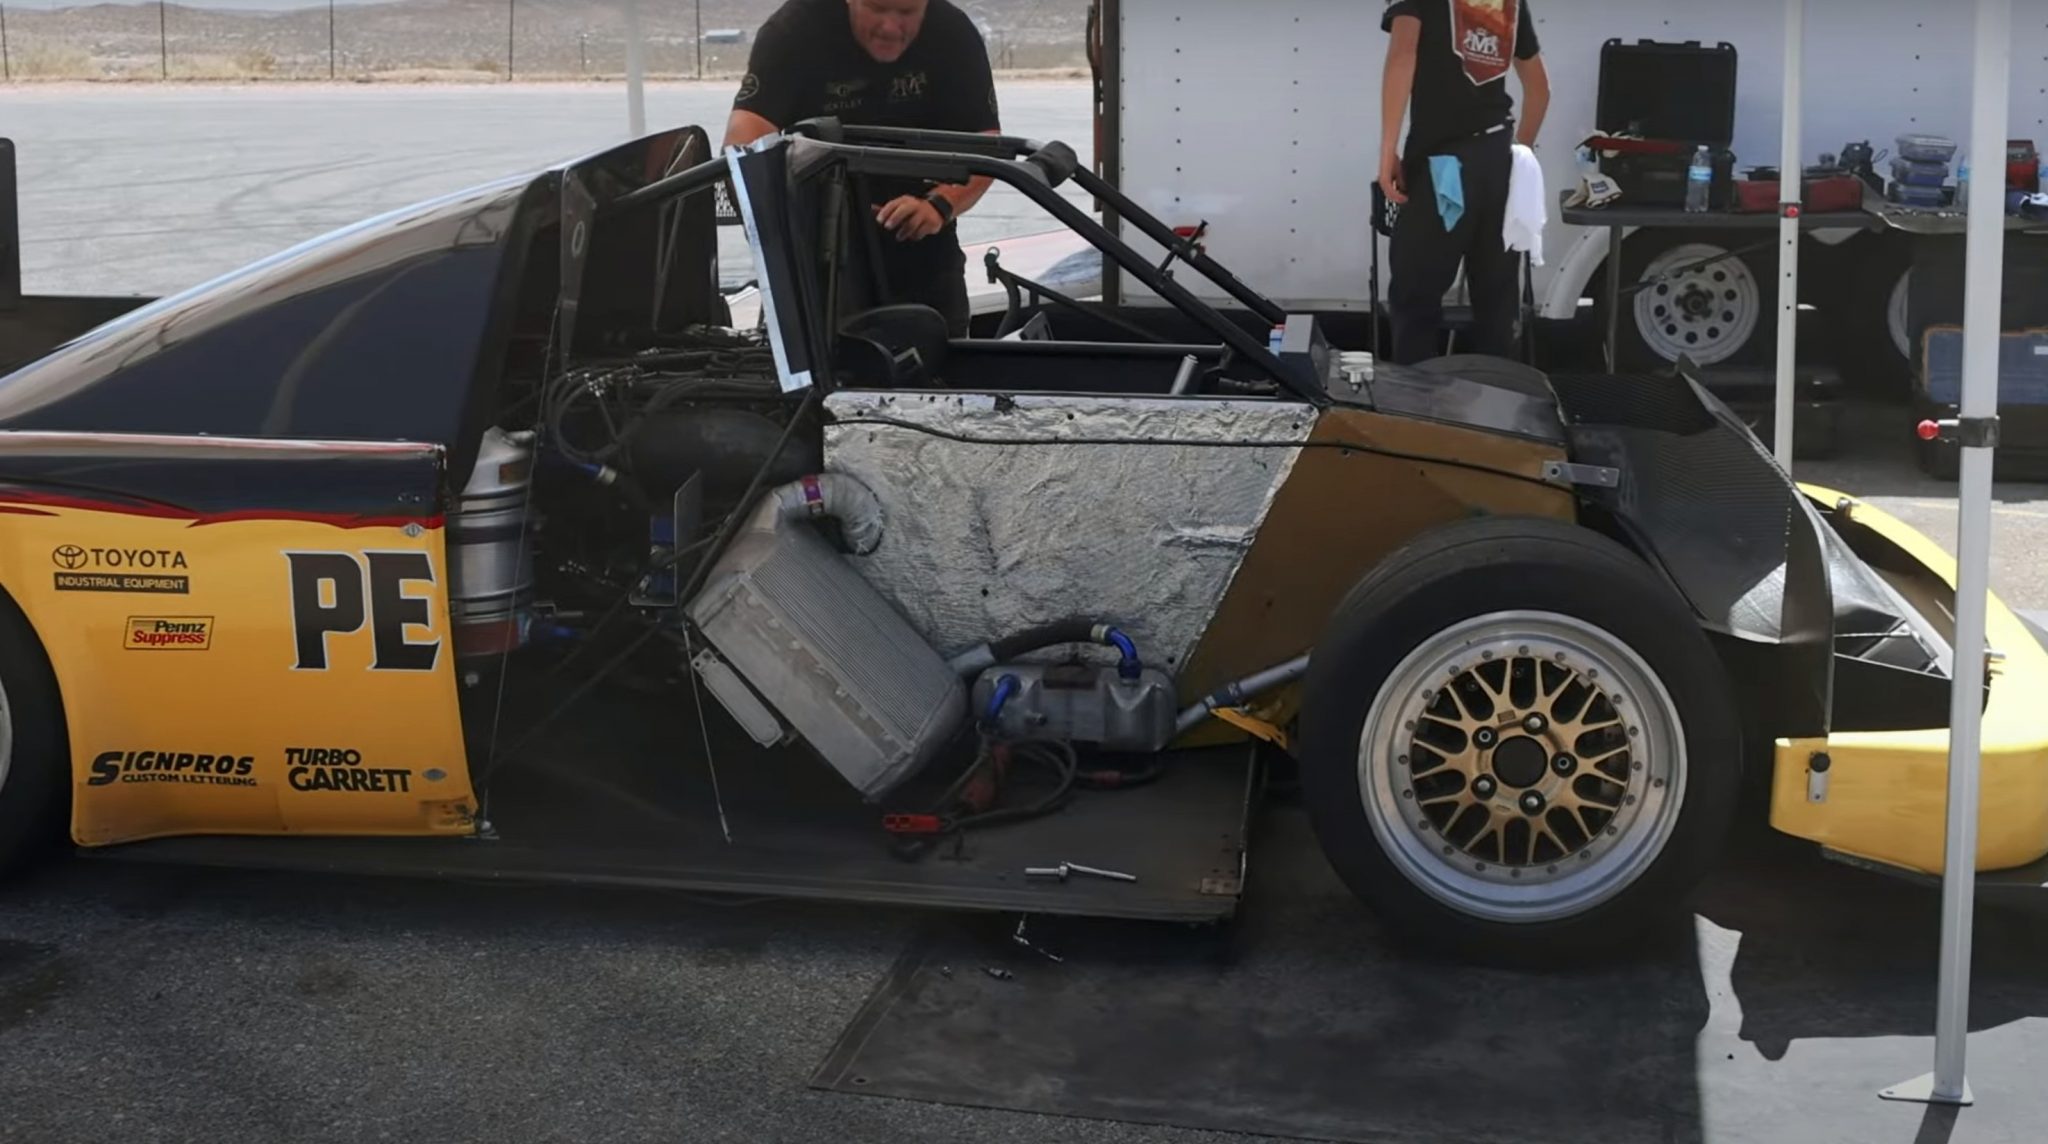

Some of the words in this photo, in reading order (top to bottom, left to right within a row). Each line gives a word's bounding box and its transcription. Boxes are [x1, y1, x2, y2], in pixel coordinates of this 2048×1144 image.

[90, 548, 188, 569] TOYOTA
[57, 576, 121, 588] INDUSTRIAL
[123, 579, 185, 590] EQUIPMENT
[280, 550, 441, 672] PE
[154, 620, 206, 633] Pennz
[132, 630, 206, 646] Suppress
[285, 748, 361, 766] TURBO
[87, 751, 254, 786] SIGNPROS
[122, 774, 182, 783] CUSTOM
[183, 776, 257, 786] LETTERING
[288, 766, 412, 792] GARRETT
